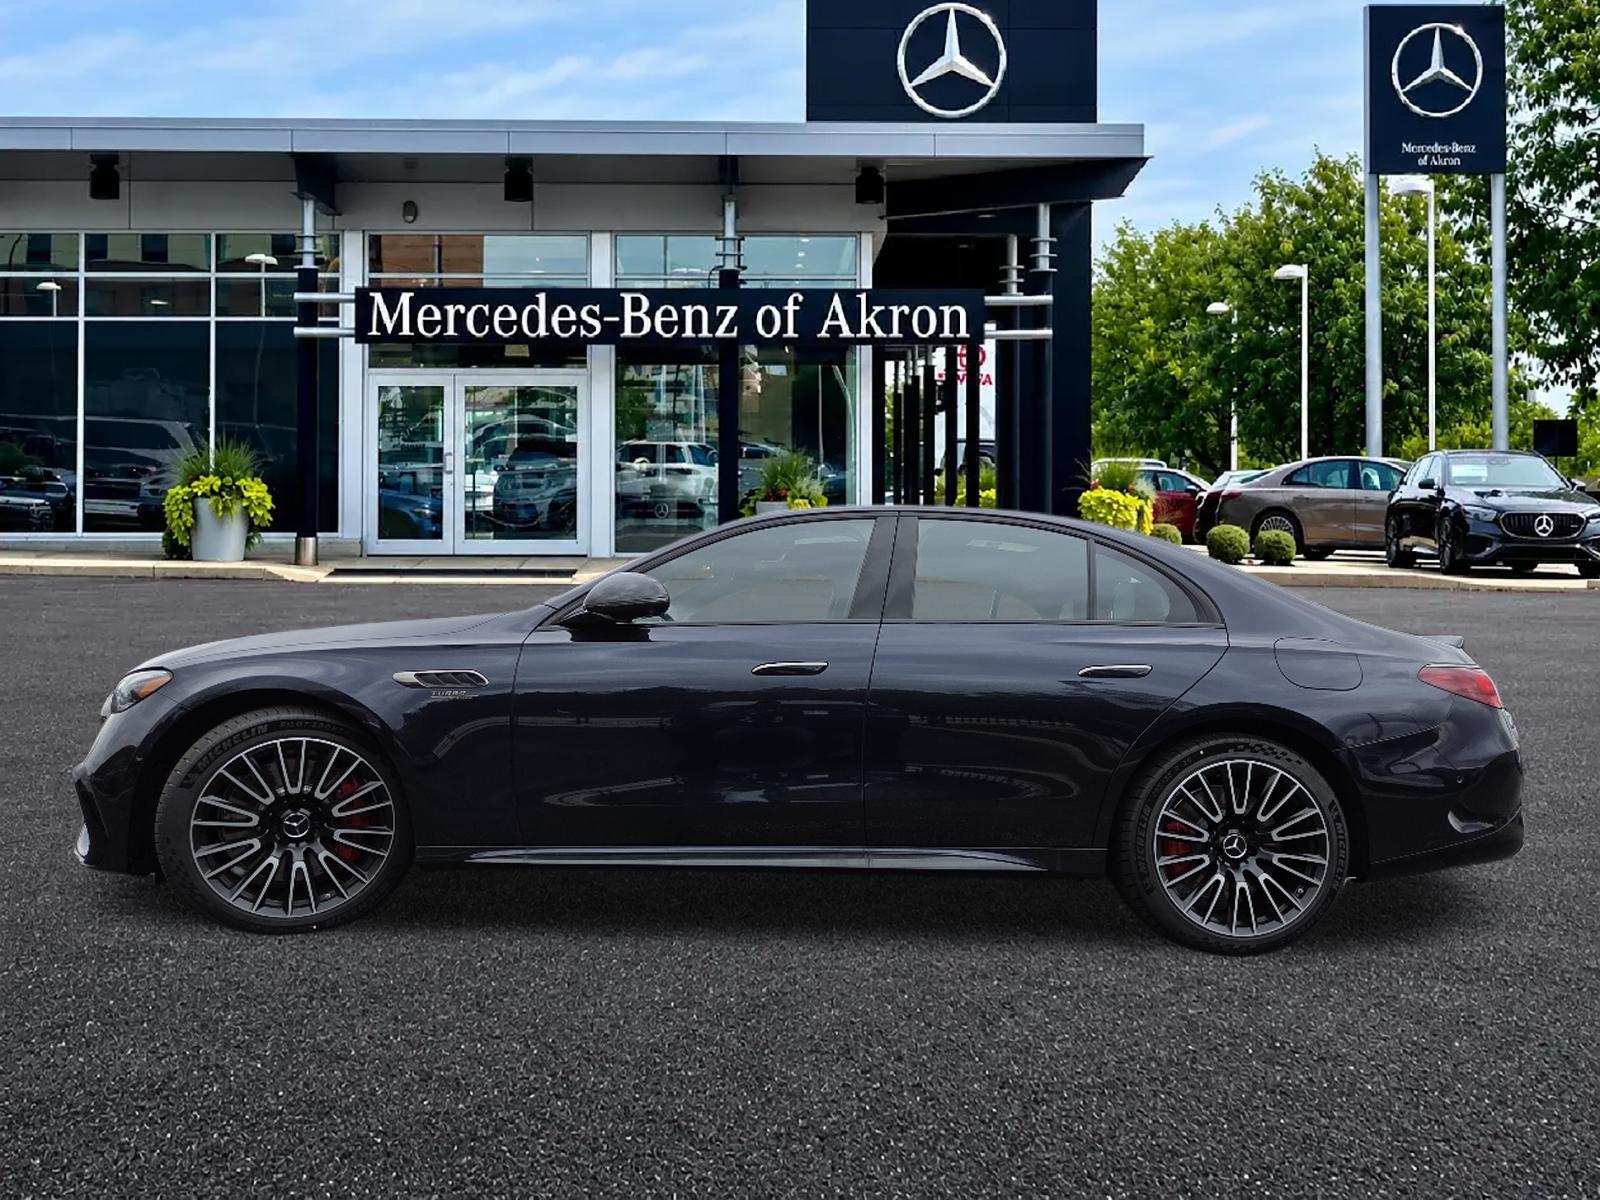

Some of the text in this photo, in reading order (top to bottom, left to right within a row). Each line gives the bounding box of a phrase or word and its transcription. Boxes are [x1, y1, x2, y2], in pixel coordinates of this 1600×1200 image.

[1401, 142, 1477, 154] Mercedes-Benz
[1417, 154, 1461, 166] of Akron
[367, 292, 970, 338] Mercedes-Benz of Akron
[196, 723, 269, 770] MICHELIN
